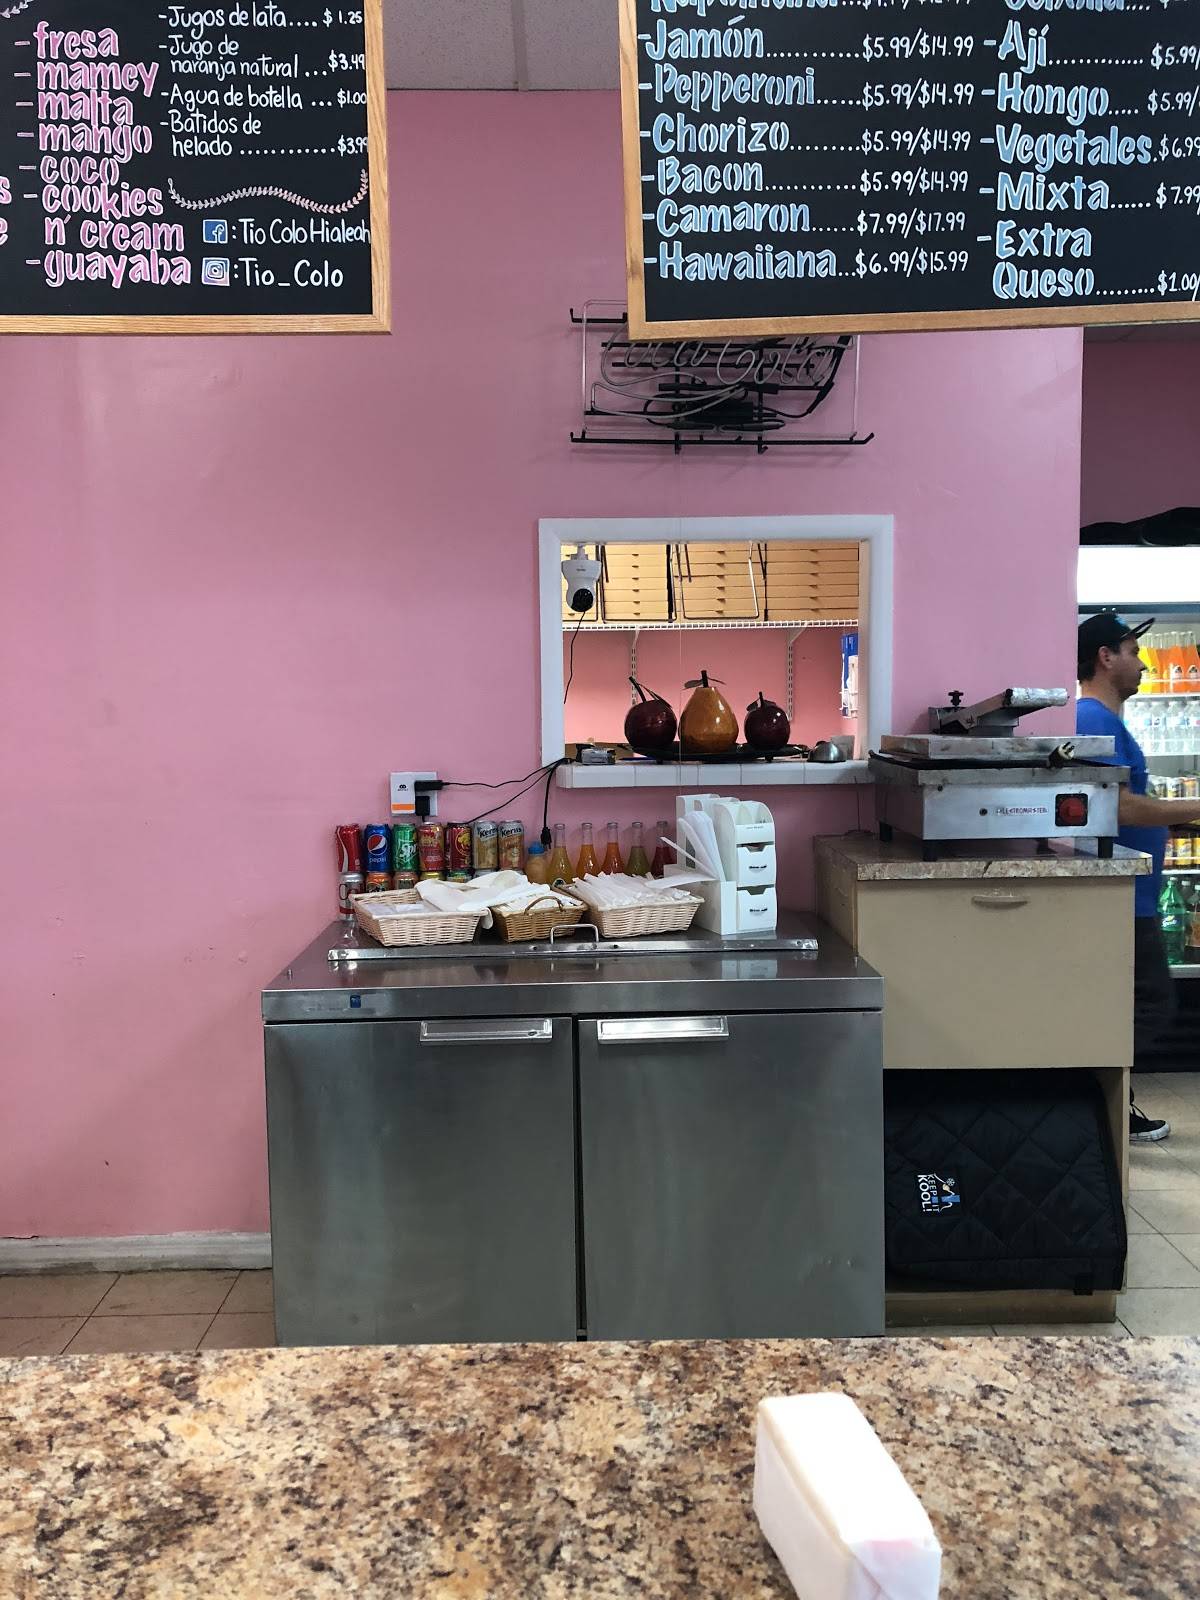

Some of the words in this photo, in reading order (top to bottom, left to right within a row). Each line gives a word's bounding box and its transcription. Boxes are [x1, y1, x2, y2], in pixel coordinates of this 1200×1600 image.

[33, 21, 119, 59] fresa
[168, 6, 225, 40] Jugos
[229, 2, 249, 26] de
[645, 15, 764, 60] Jamón
[168, 34, 213, 60] Jugo
[218, 33, 239, 55] de
[998, 19, 1049, 74] Ají
[37, 61, 159, 97] mamey
[170, 56, 236, 81] naranja
[240, 53, 299, 78] natural
[170, 83, 220, 112] Agua
[223, 84, 243, 106] de
[247, 84, 303, 109] botella
[655, 63, 815, 112] Pepperoni
[997, 72, 1109, 126] Hongo
[38, 89, 133, 126] malta
[168, 108, 238, 133] Batidos
[242, 111, 262, 134] de
[39, 123, 152, 163] mango
[172, 134, 233, 157] helado
[653, 113, 790, 153] Chorizo
[996, 123, 1153, 173] Vegetales
[40, 156, 119, 185] coco
[657, 156, 763, 196] Bacon
[42, 182, 163, 220] cookies
[997, 171, 1110, 211] Mixta
[80, 219, 184, 251] cream
[269, 218, 308, 244] Colo
[657, 198, 810, 237] Camaron
[995, 220, 1092, 259] Extra
[44, 250, 191, 288] guayaba
[659, 241, 836, 281] Hawaiiana
[992, 261, 1095, 299] Queso
[917, 1174, 933, 1212] KOOL!
[927, 1173, 938, 1196] KEEP
